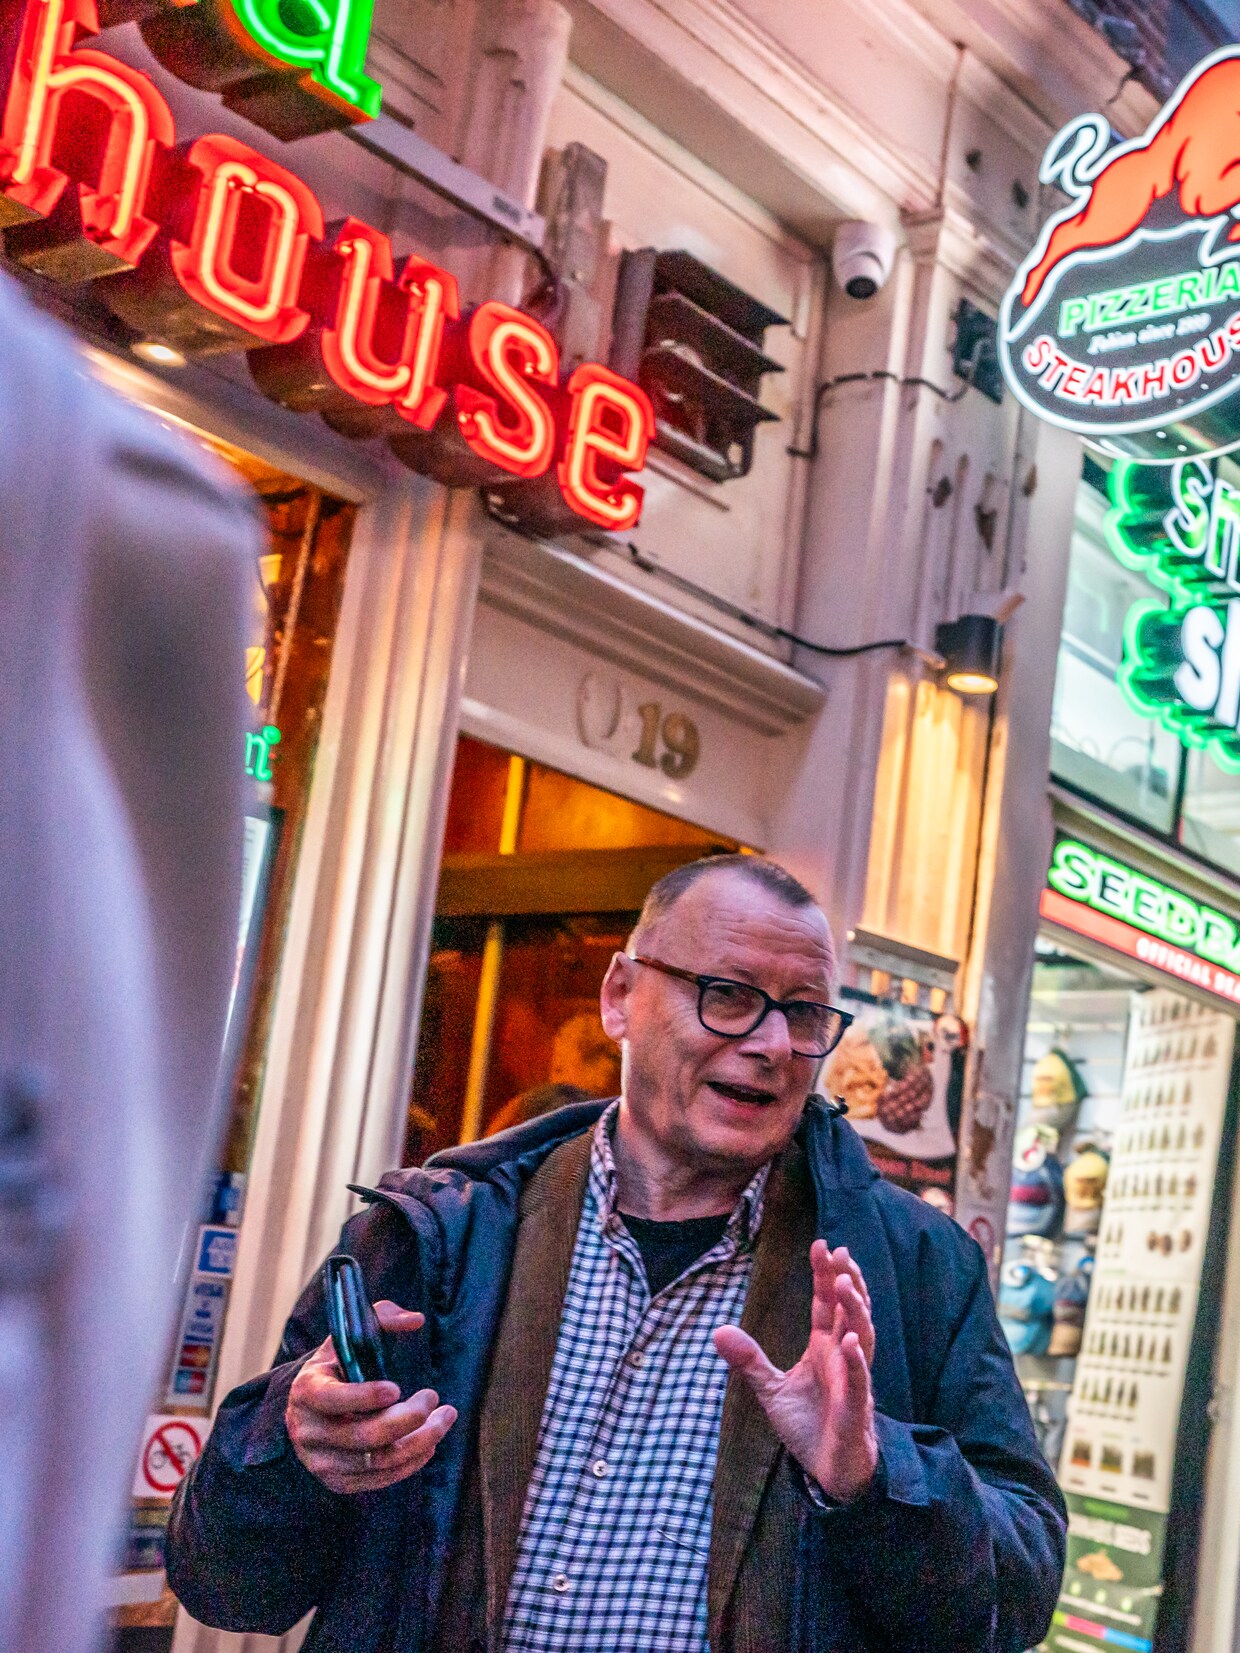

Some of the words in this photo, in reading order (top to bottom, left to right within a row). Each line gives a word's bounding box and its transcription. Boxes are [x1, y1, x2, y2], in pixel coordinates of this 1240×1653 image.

[0, 0, 655, 531] house
[631, 701, 700, 780] 19
[1135, 936, 1211, 986] OFFICIAL
